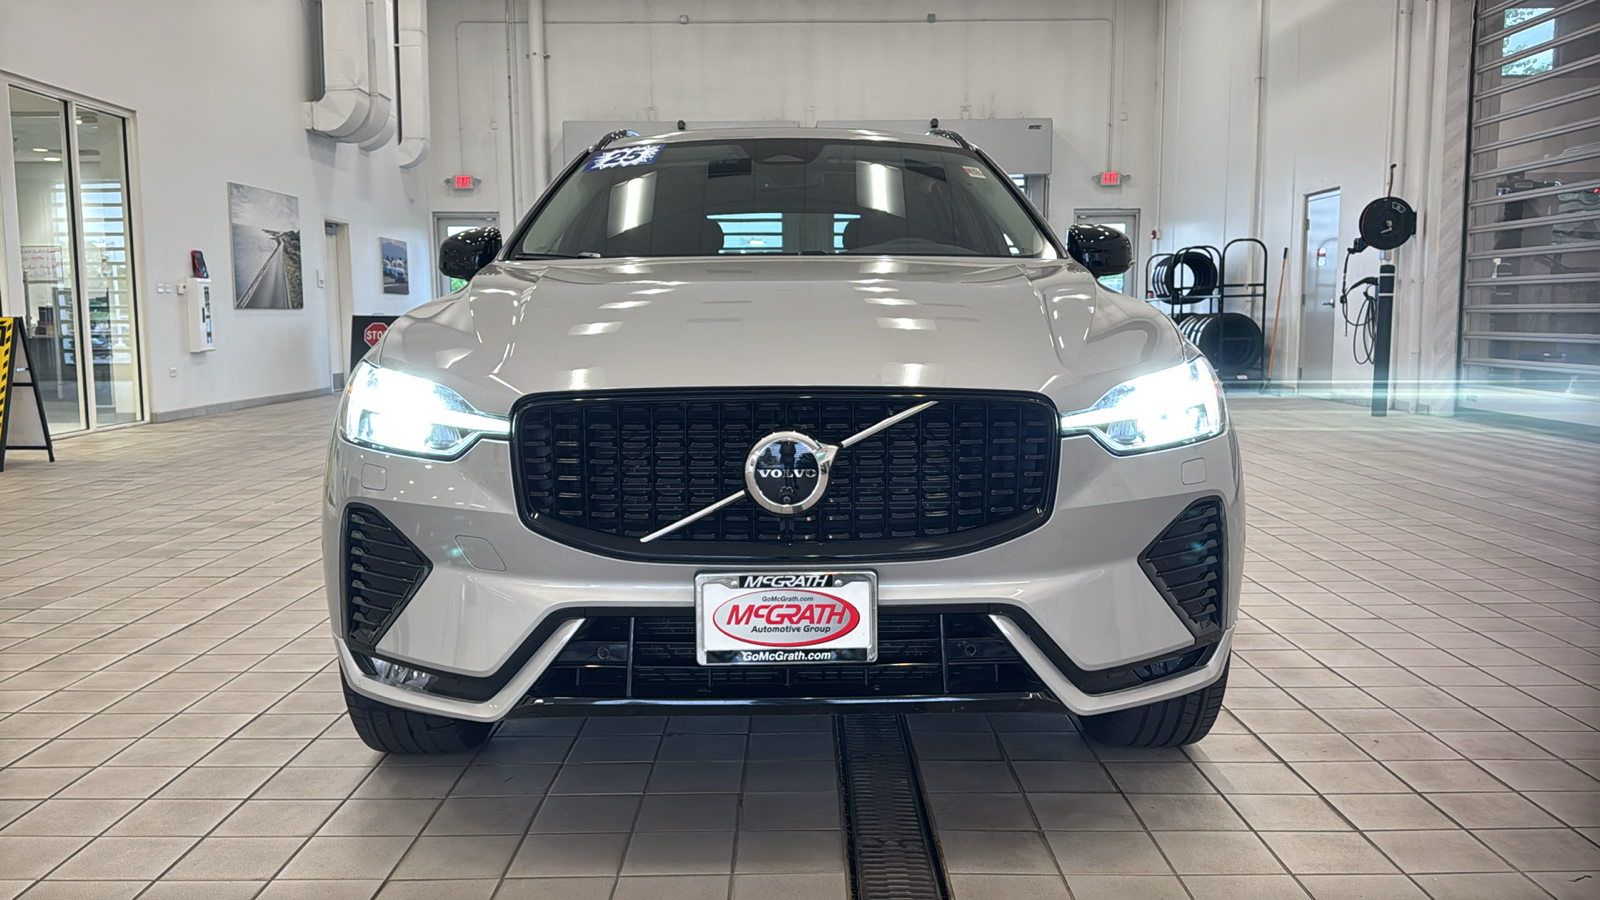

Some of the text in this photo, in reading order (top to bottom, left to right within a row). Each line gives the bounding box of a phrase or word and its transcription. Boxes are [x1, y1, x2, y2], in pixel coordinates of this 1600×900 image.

[603, 149, 645, 164] 25
[455, 175, 470, 187] EXIT
[1103, 172, 1118, 184] EXIT
[366, 330, 384, 340] STO
[757, 469, 817, 478] VOLVO
[751, 625, 831, 634] Automotive Group
[742, 651, 831, 661] GoMcGrath.com
